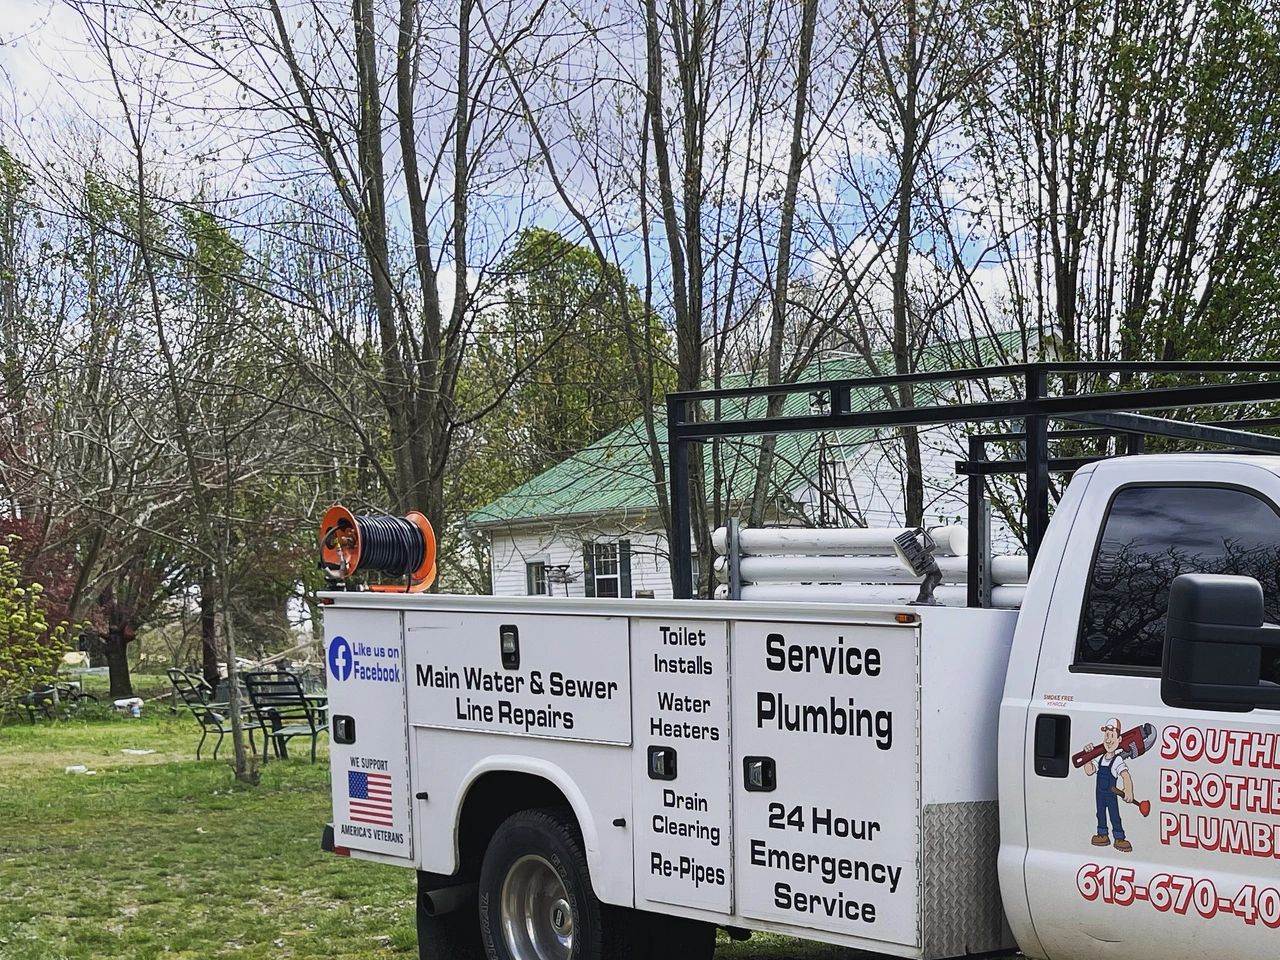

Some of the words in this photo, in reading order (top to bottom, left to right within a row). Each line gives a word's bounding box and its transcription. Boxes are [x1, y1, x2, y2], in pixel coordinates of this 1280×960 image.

[353, 642, 371, 656] Like
[374, 647, 385, 658] us
[388, 648, 399, 658] on
[659, 626, 706, 647] Toilet
[654, 653, 713, 675] Installs
[766, 633, 881, 677] Service
[354, 661, 400, 683] Facebook
[415, 664, 460, 689] Main
[464, 667, 524, 694] Water
[530, 671, 545, 695] &
[549, 672, 618, 700] Sewer
[456, 697, 494, 723] Line
[498, 700, 574, 732] Repairs
[658, 691, 711, 714] Water
[650, 717, 719, 741] Heaters
[757, 691, 893, 750] Plumbing
[350, 756, 360, 768] WE
[361, 758, 388, 771] SUPPORT
[663, 789, 708, 812] Drain
[341, 824, 372, 839] AMERICA'S
[373, 829, 404, 844] VETERANS
[652, 815, 720, 846] Clearing
[768, 803, 804, 832] 24
[812, 808, 880, 841] Hour
[651, 852, 725, 888] Re-Pipes
[750, 839, 902, 893] Emergency
[774, 882, 876, 923] Service
